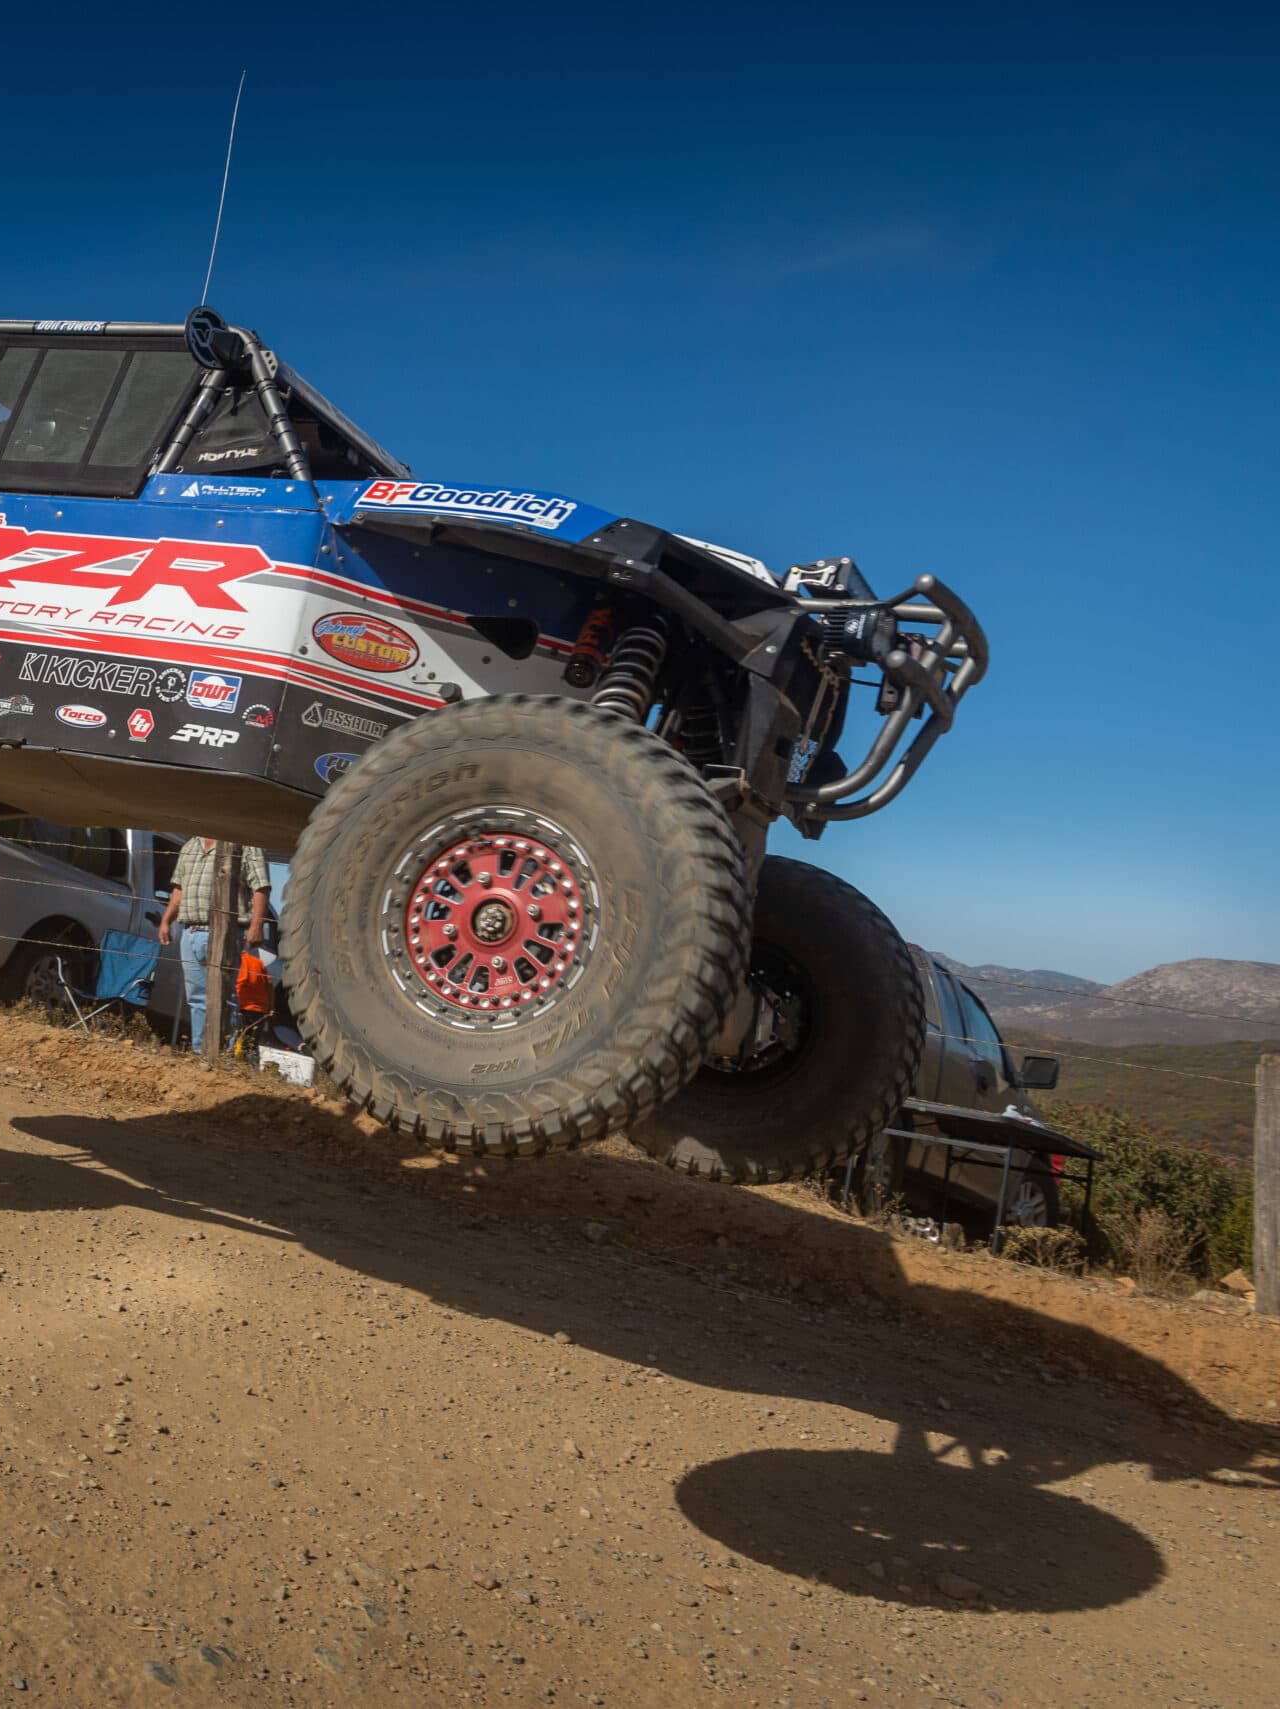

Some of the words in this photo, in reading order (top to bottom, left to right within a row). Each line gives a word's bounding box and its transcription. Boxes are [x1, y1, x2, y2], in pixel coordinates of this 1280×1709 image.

[364, 481, 570, 519] BFGoodrich
[89, 611, 246, 639] RACING
[332, 635, 410, 665] CUSTOM
[42, 655, 157, 697] KICKER
[191, 682, 237, 702] DWT
[62, 707, 103, 722] Torco
[169, 723, 240, 748] PRP
